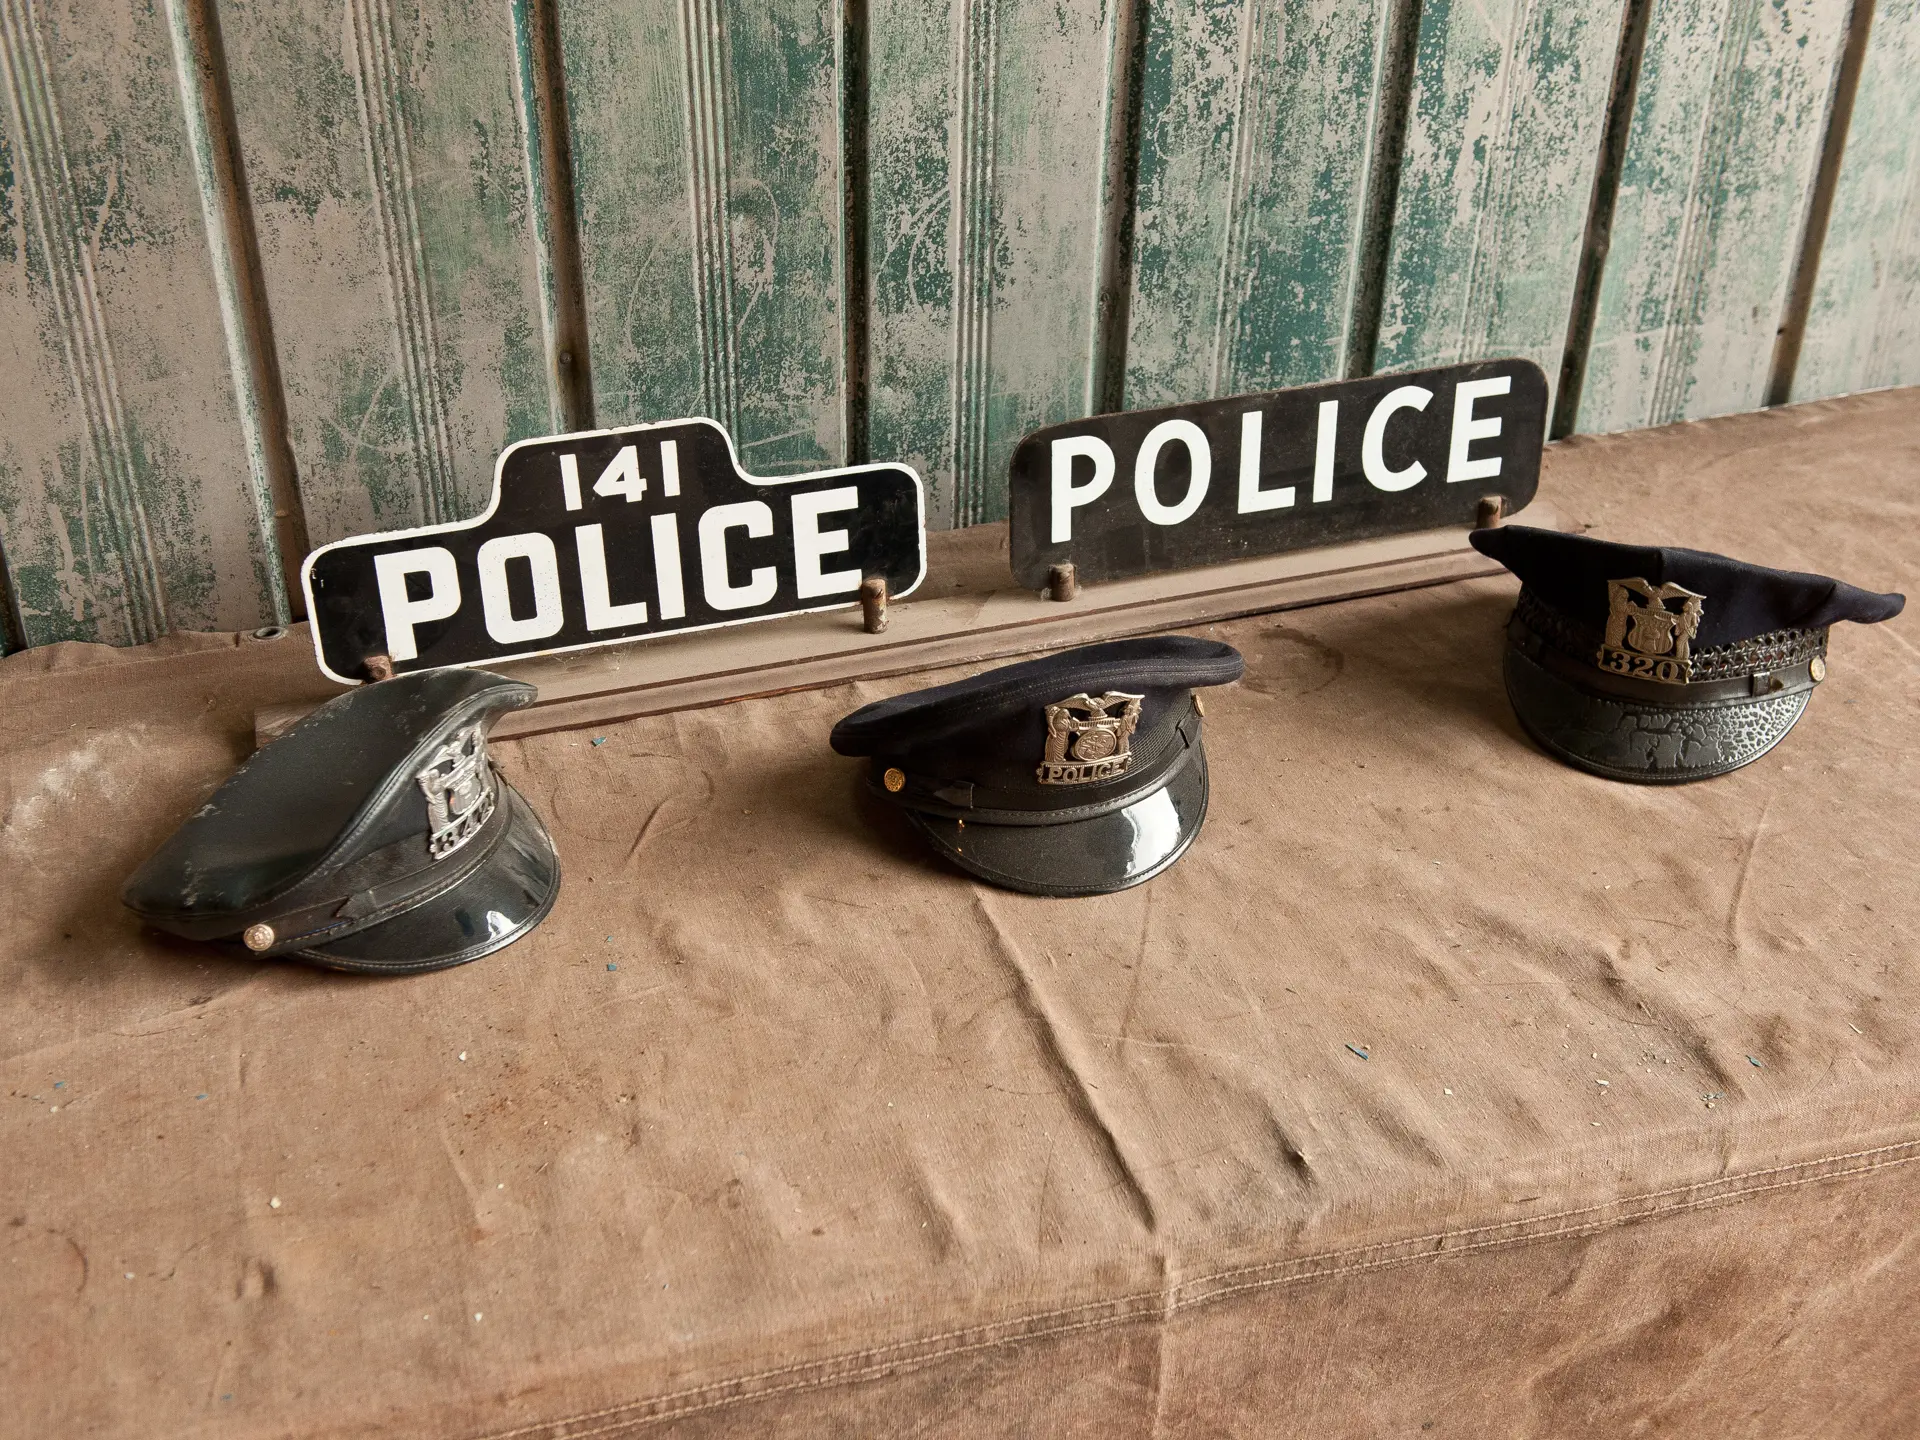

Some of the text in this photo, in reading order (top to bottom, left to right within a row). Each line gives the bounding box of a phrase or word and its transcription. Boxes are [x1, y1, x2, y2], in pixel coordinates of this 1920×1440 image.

[560, 440, 680, 511] 141
[1051, 375, 1511, 543] POLICE
[374, 486, 864, 662] POLICE
[1609, 651, 1679, 681] 320
[1048, 762, 1123, 783] POLICE
